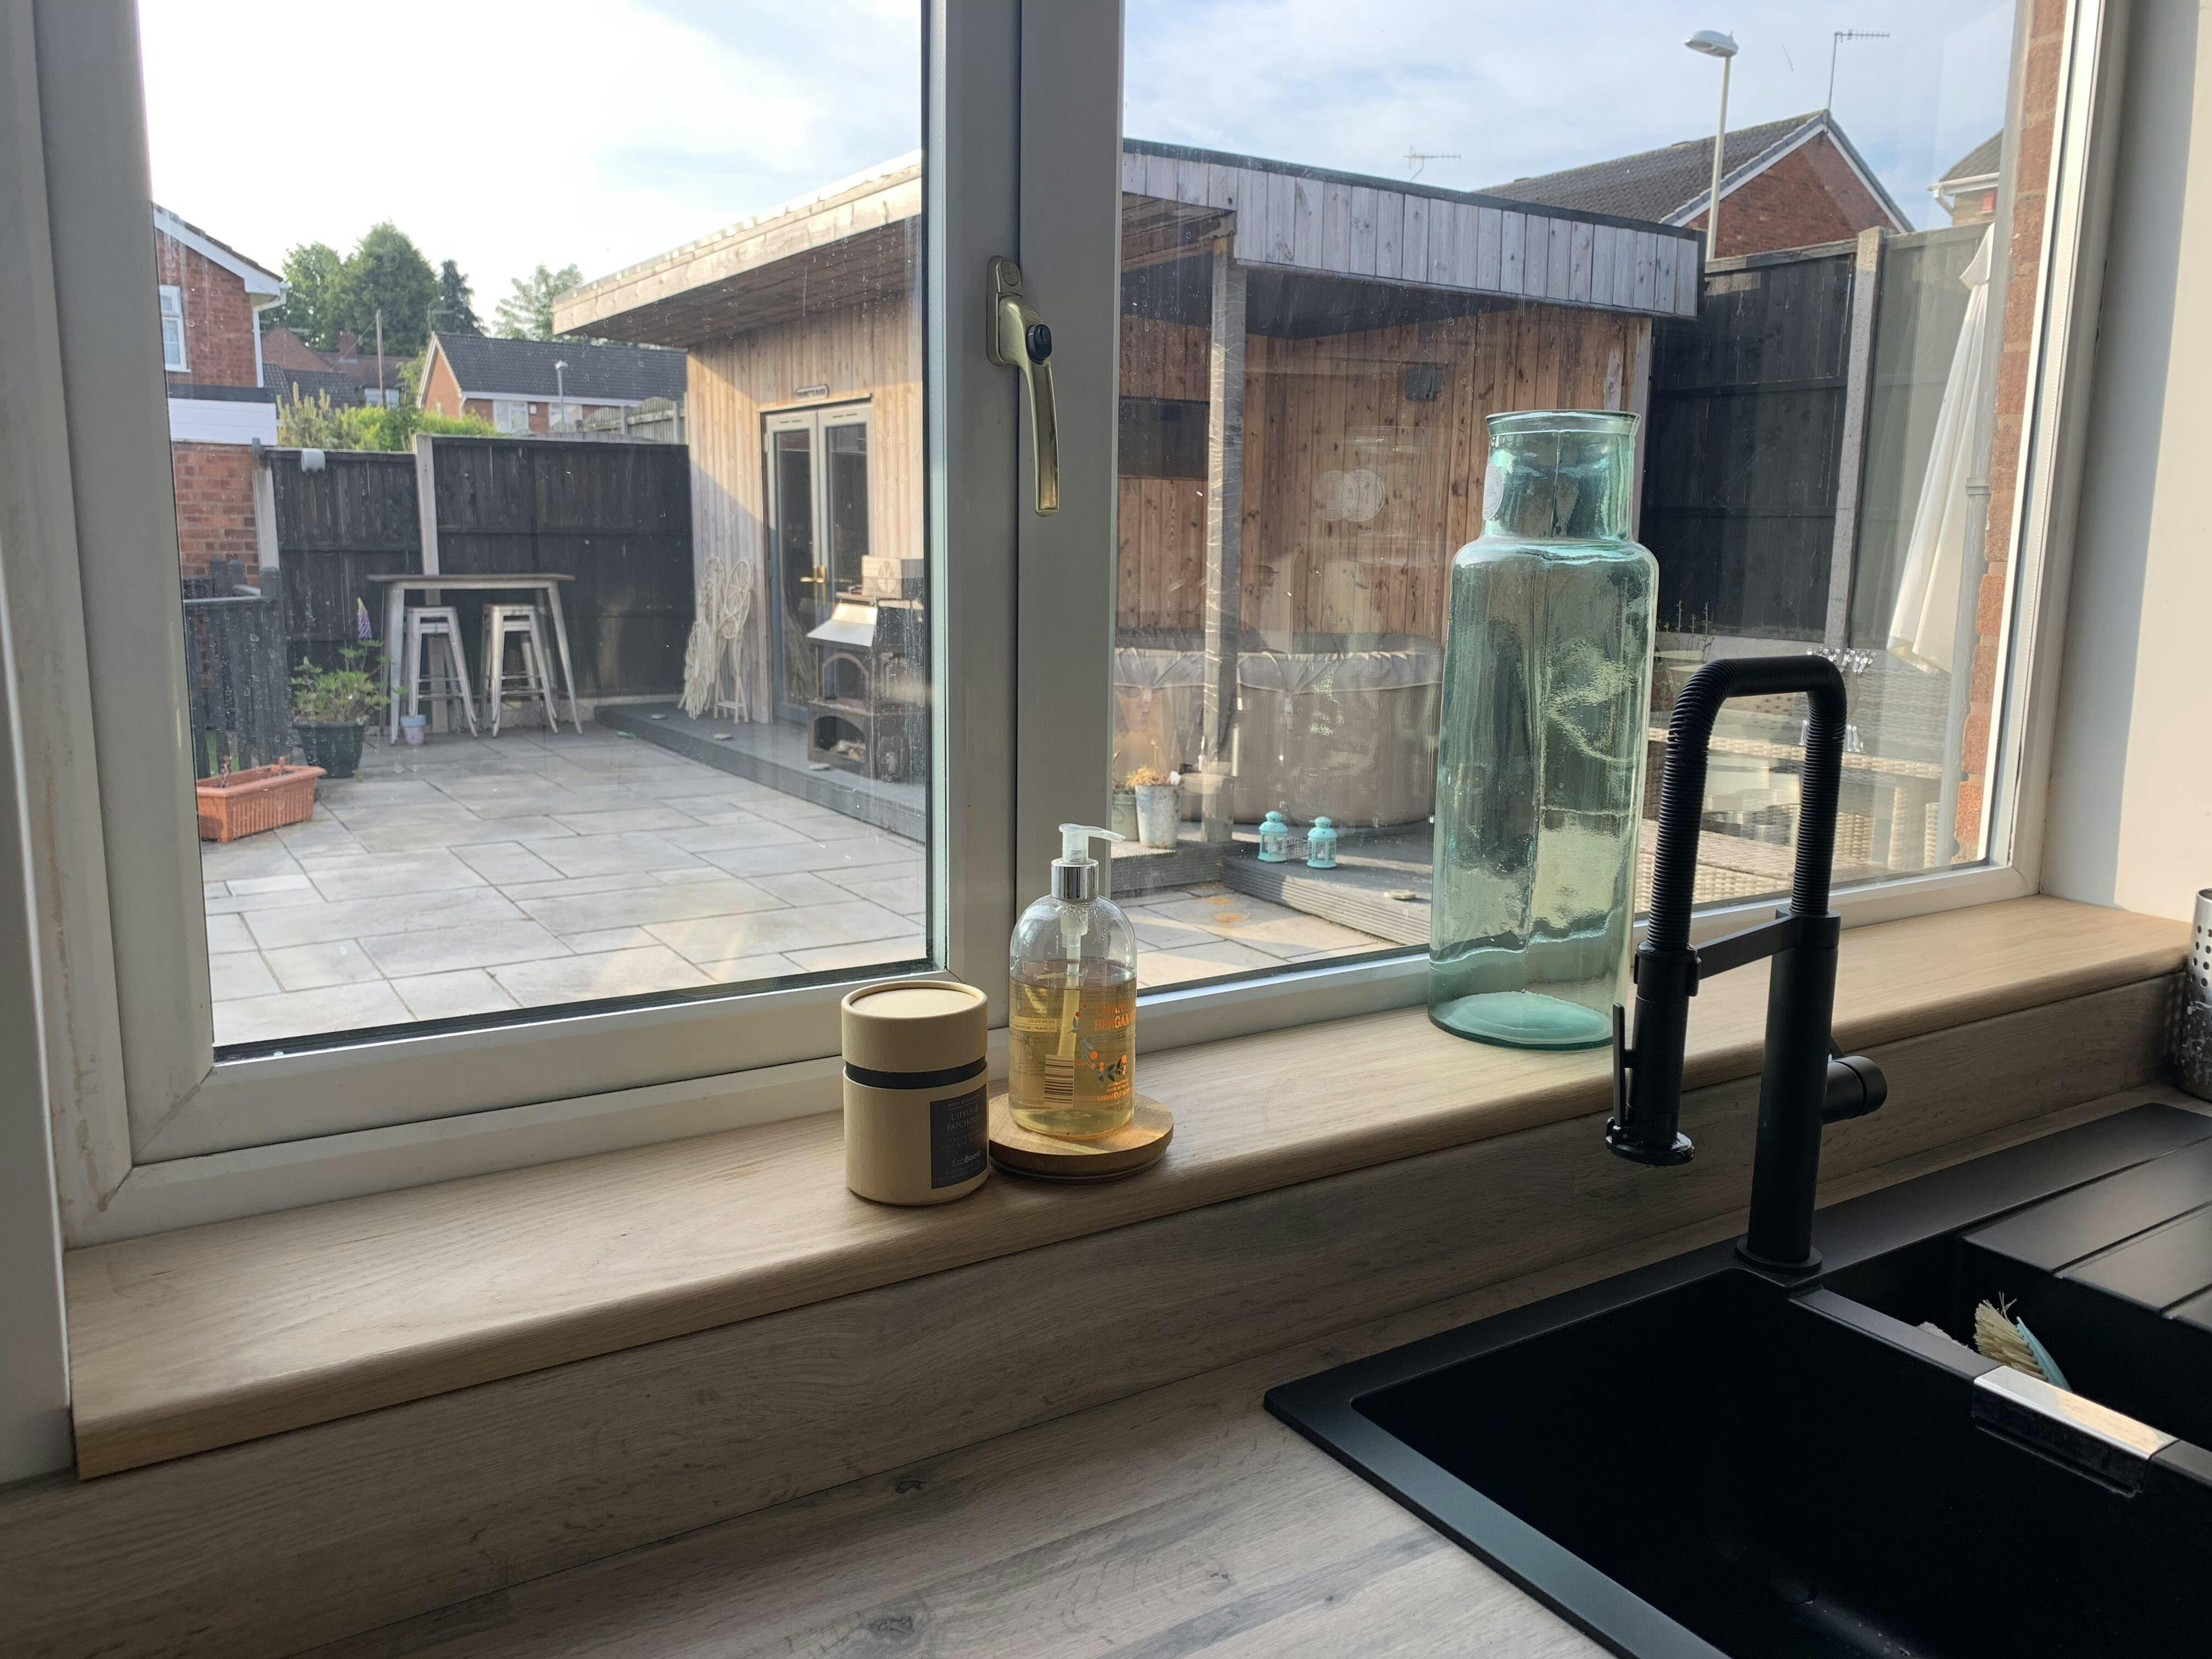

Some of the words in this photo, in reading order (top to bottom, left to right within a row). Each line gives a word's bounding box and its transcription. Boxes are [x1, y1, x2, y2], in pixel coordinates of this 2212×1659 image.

[947, 1114, 982, 1131] PATCHOULI
[951, 1107, 974, 1121] CITRUS
[952, 1150, 981, 1167] EcoBoost
